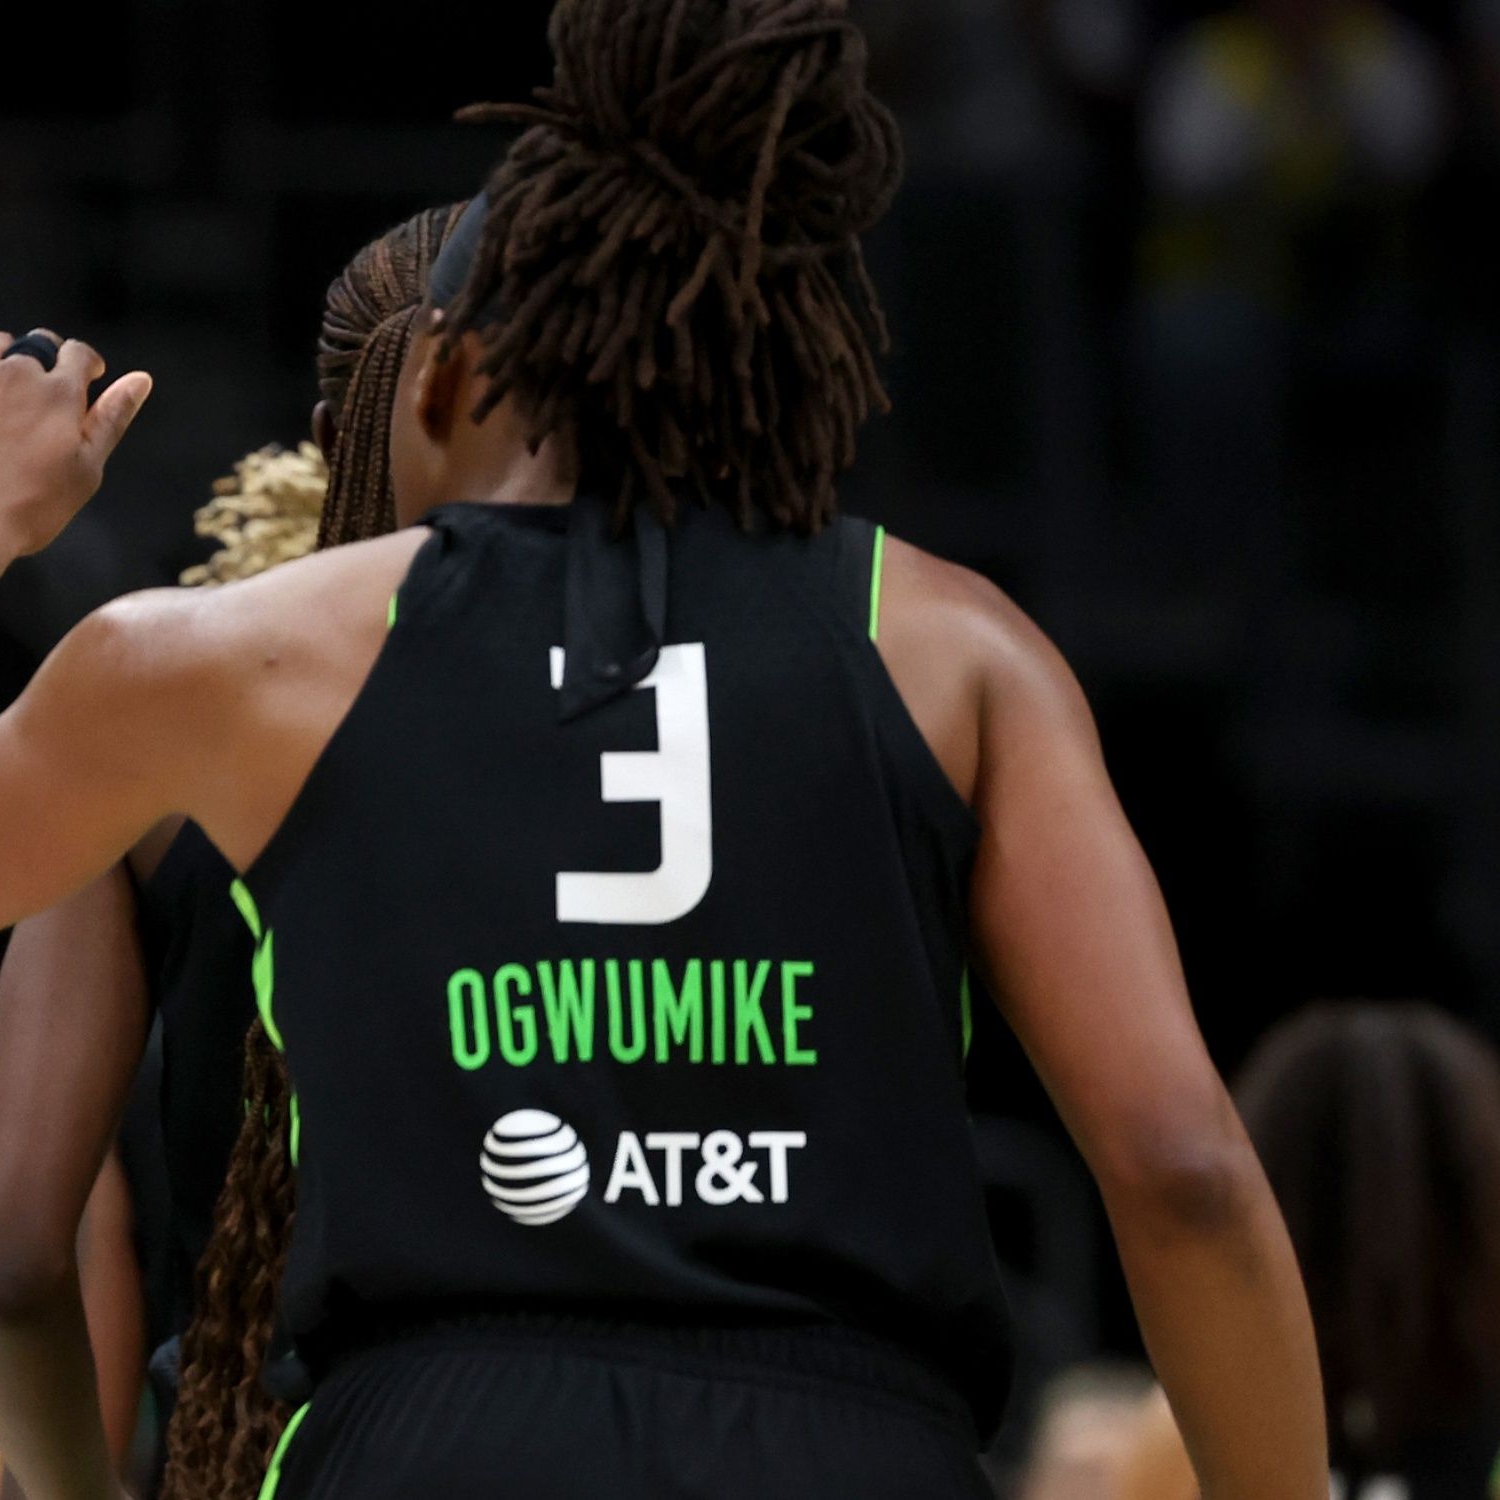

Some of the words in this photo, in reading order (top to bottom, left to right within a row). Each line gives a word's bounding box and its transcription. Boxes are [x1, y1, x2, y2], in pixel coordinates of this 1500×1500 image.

[550, 642, 713, 924] 3
[447, 958, 818, 1070] OGWUMIKE
[604, 1130, 807, 1206] AT&T
